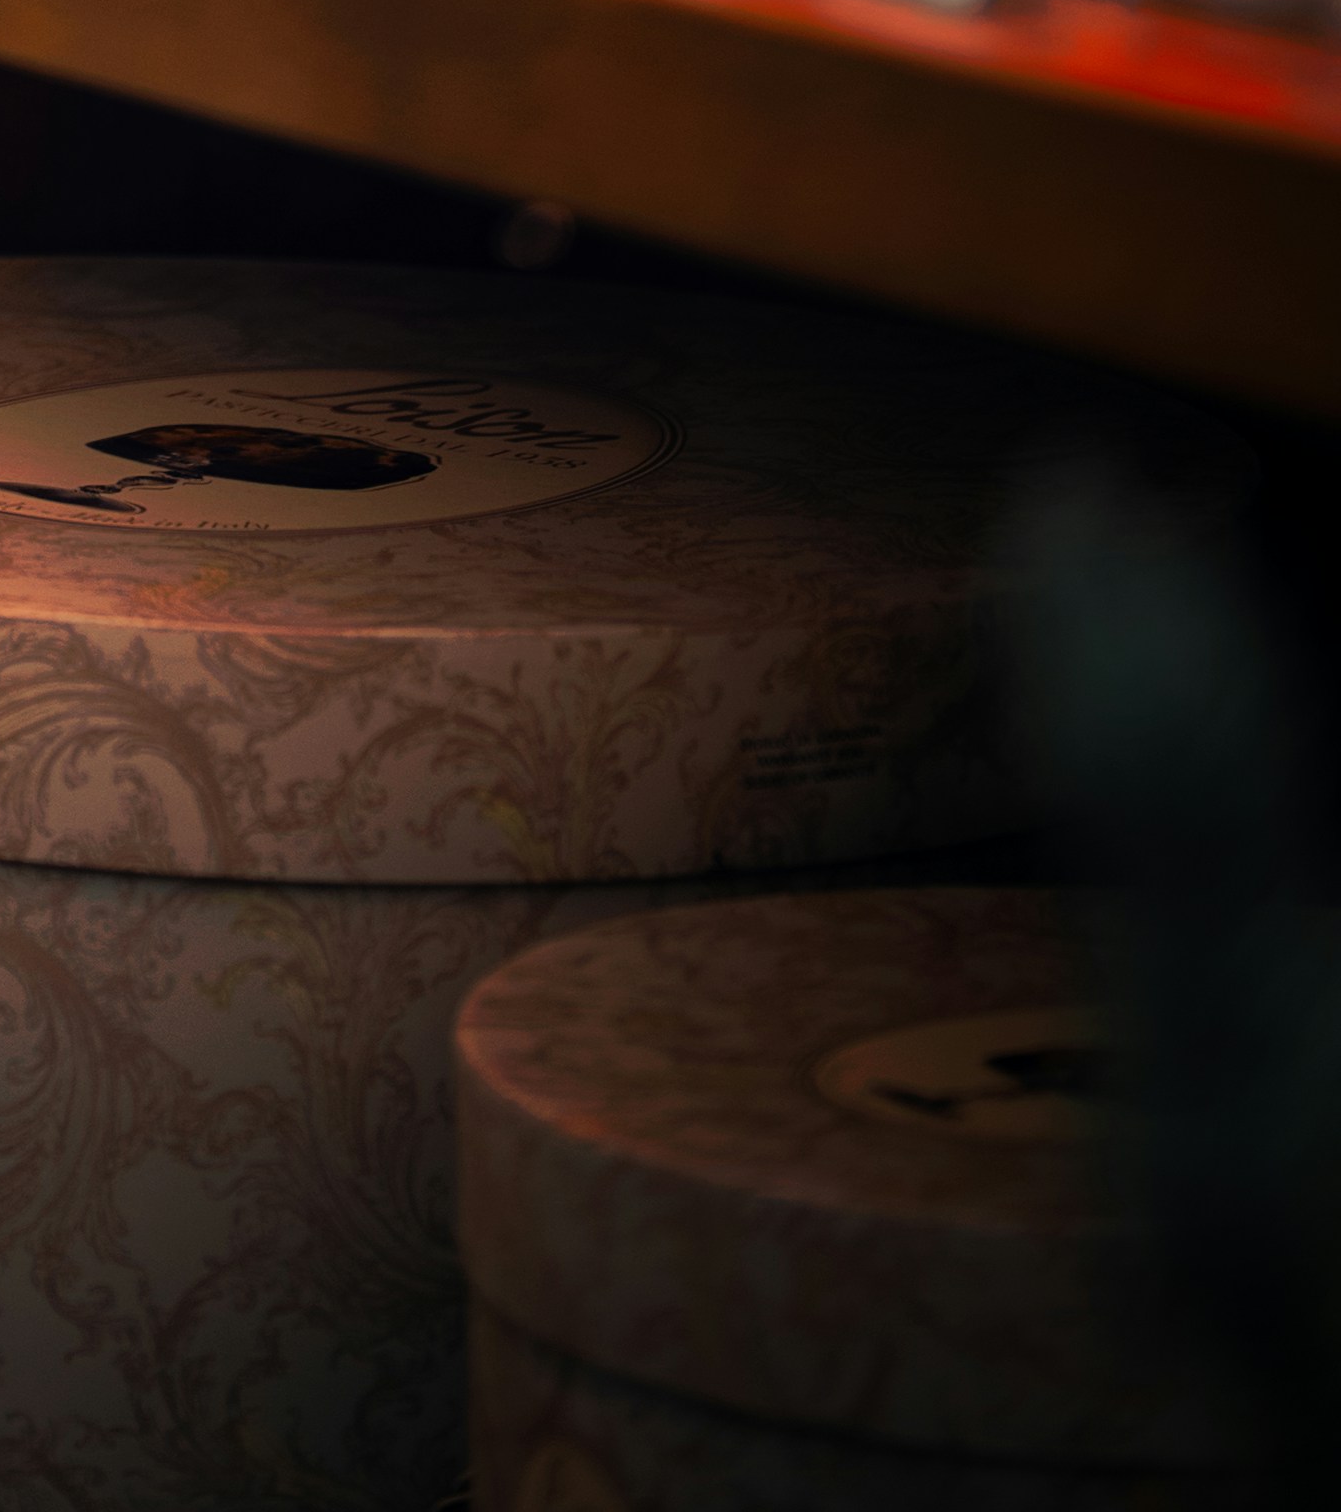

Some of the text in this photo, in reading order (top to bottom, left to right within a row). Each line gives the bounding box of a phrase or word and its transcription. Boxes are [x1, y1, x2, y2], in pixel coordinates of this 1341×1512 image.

[165, 389, 588, 470] PASTICCERI DAL 1938
[228, 378, 622, 451] Loison
